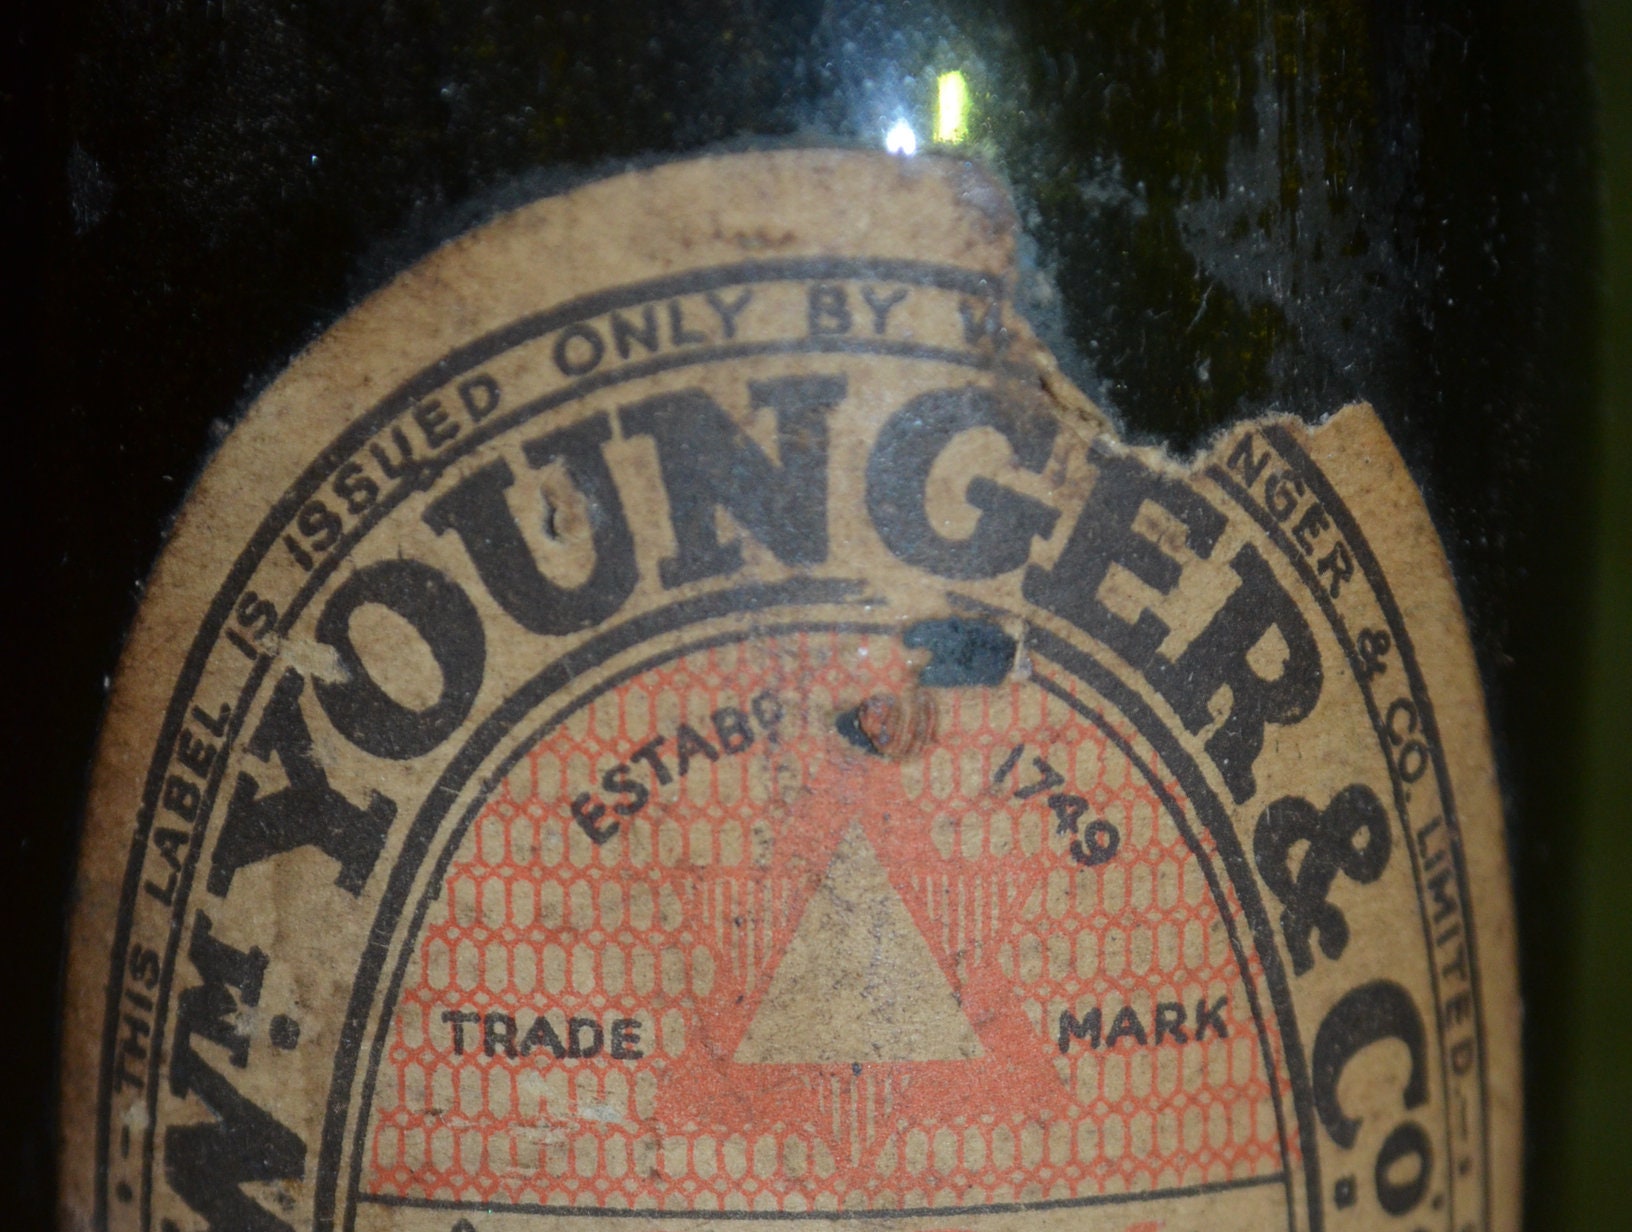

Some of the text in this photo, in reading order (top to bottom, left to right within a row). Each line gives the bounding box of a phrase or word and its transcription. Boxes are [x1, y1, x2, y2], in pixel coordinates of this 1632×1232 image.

[113, 945, 160, 1094] THIS
[145, 702, 232, 907] LABEL
[225, 590, 278, 660] IS
[283, 372, 500, 571] ISSUED
[553, 287, 753, 376] ONLY
[806, 283, 908, 337] BY
[206, 372, 1324, 900] YOUNGER
[1253, 782, 1393, 977] &
[1356, 626, 1392, 682] &
[994, 743, 1121, 867] 1749
[441, 995, 1230, 1060] TRADE MARK
